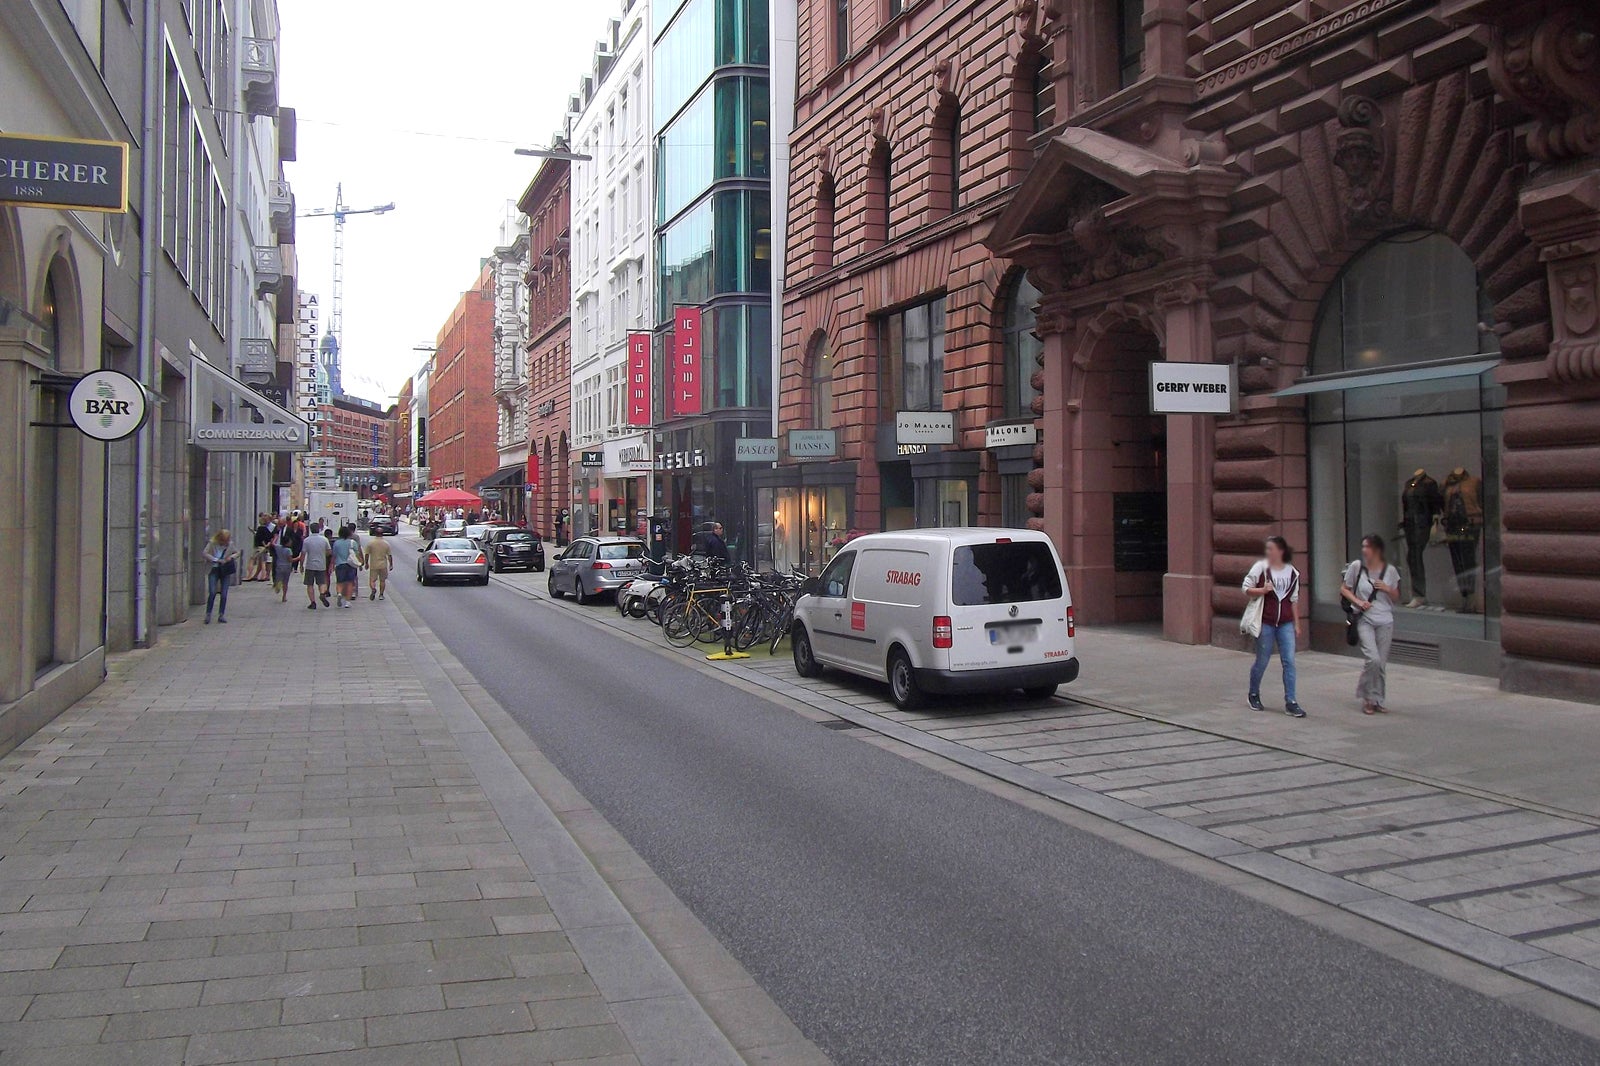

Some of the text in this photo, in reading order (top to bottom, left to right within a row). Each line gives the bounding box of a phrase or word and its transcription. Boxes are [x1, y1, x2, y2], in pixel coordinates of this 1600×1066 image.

[15, 185, 43, 197] 1888
[307, 295, 318, 437] ALSTERHAUS
[684, 319, 693, 401] TESLA
[635, 343, 644, 415] TESLA
[1156, 382, 1227, 394] GERRY WEBER
[85, 399, 130, 416] BÄR
[197, 428, 287, 440] COMMERZBANK
[990, 426, 1027, 436] MALONE
[737, 445, 776, 455] BASLER
[795, 442, 831, 451] HANSEN
[897, 444, 927, 455] HANSEN
[658, 449, 704, 470] TESLA
[886, 570, 921, 587] STRABAG
[1043, 650, 1069, 659] STRABAG
